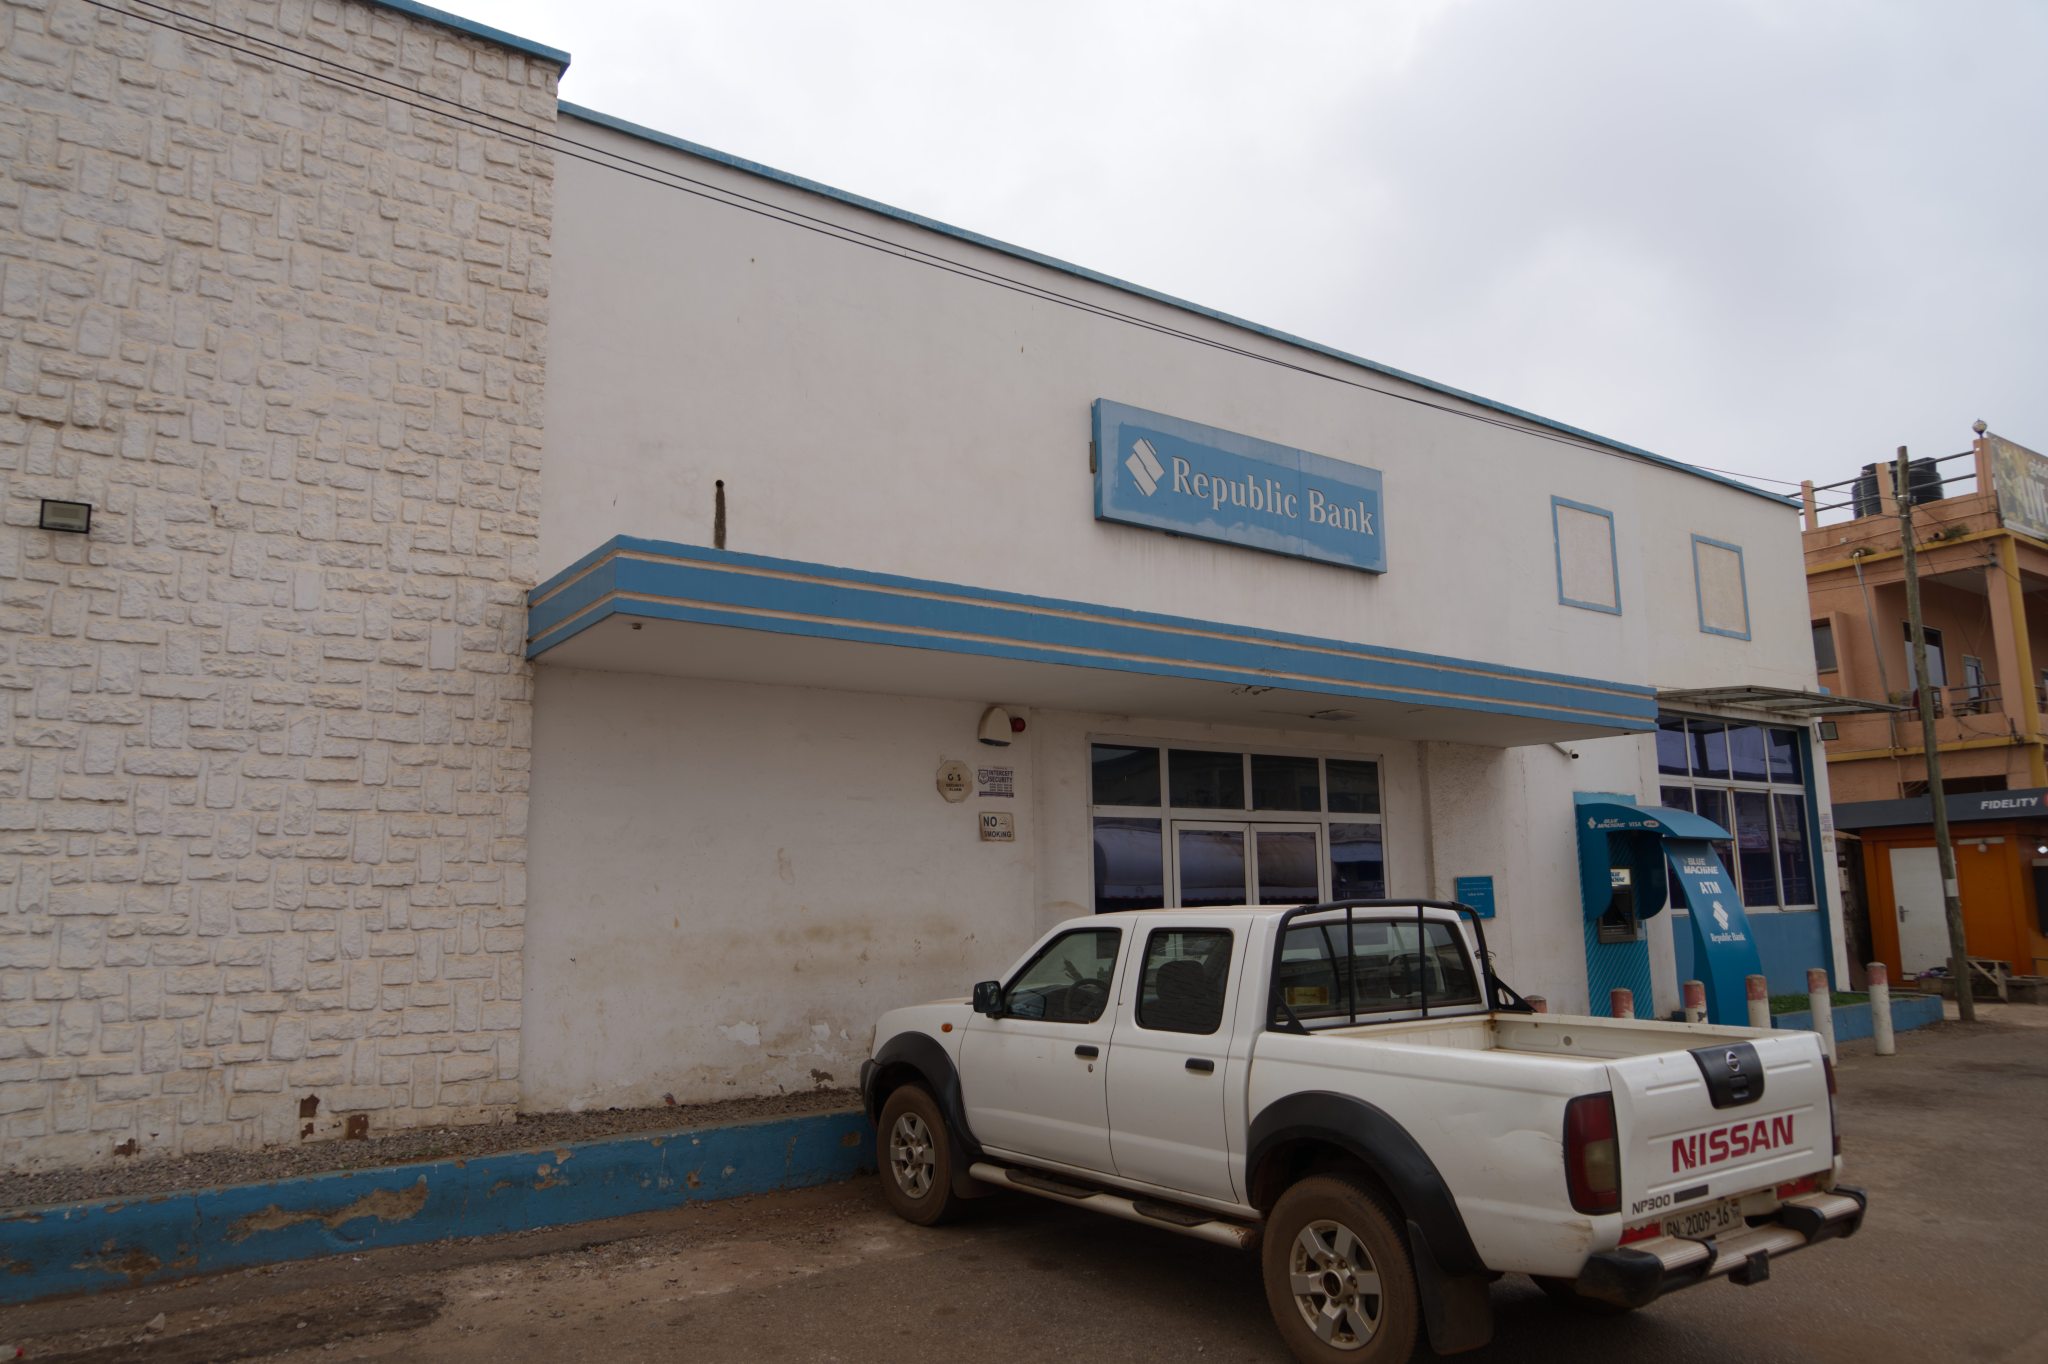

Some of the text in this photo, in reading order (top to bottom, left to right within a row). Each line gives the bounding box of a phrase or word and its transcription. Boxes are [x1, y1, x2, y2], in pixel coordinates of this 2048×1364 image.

[1171, 456, 1374, 536] Republic Bank
[1981, 797, 2038, 810] FIDELITY
[984, 816, 997, 827] NO
[984, 830, 1012, 838] SMOKING
[1684, 866, 1718, 874] MACHINE
[1699, 882, 1721, 894] ATM
[1710, 932, 1746, 943] Republic Bank
[1672, 1114, 1793, 1173] NISSAN
[1632, 1194, 1670, 1215] NP300
[1685, 1206, 1730, 1236] 2009-16
